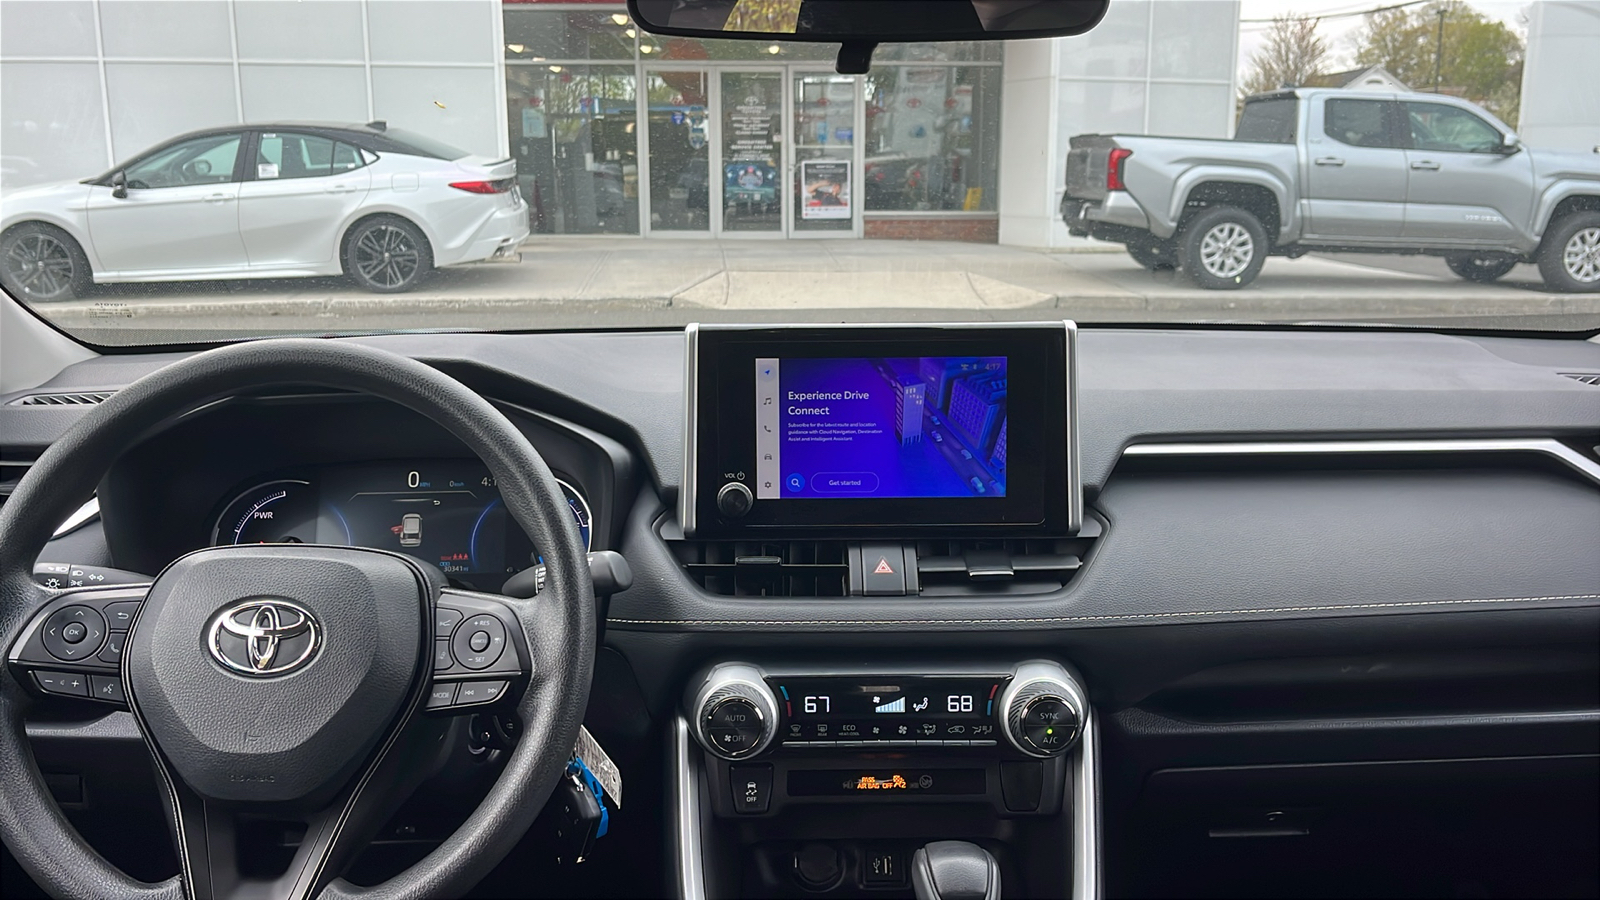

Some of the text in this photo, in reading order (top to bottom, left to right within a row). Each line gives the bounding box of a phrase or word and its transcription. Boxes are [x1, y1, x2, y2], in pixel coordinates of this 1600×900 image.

[788, 390, 870, 402] Experience Drive
[788, 406, 830, 415] Connect
[408, 471, 420, 488] 0
[481, 477, 498, 486] 4:1
[804, 696, 830, 713] 67
[948, 695, 973, 712] 68
